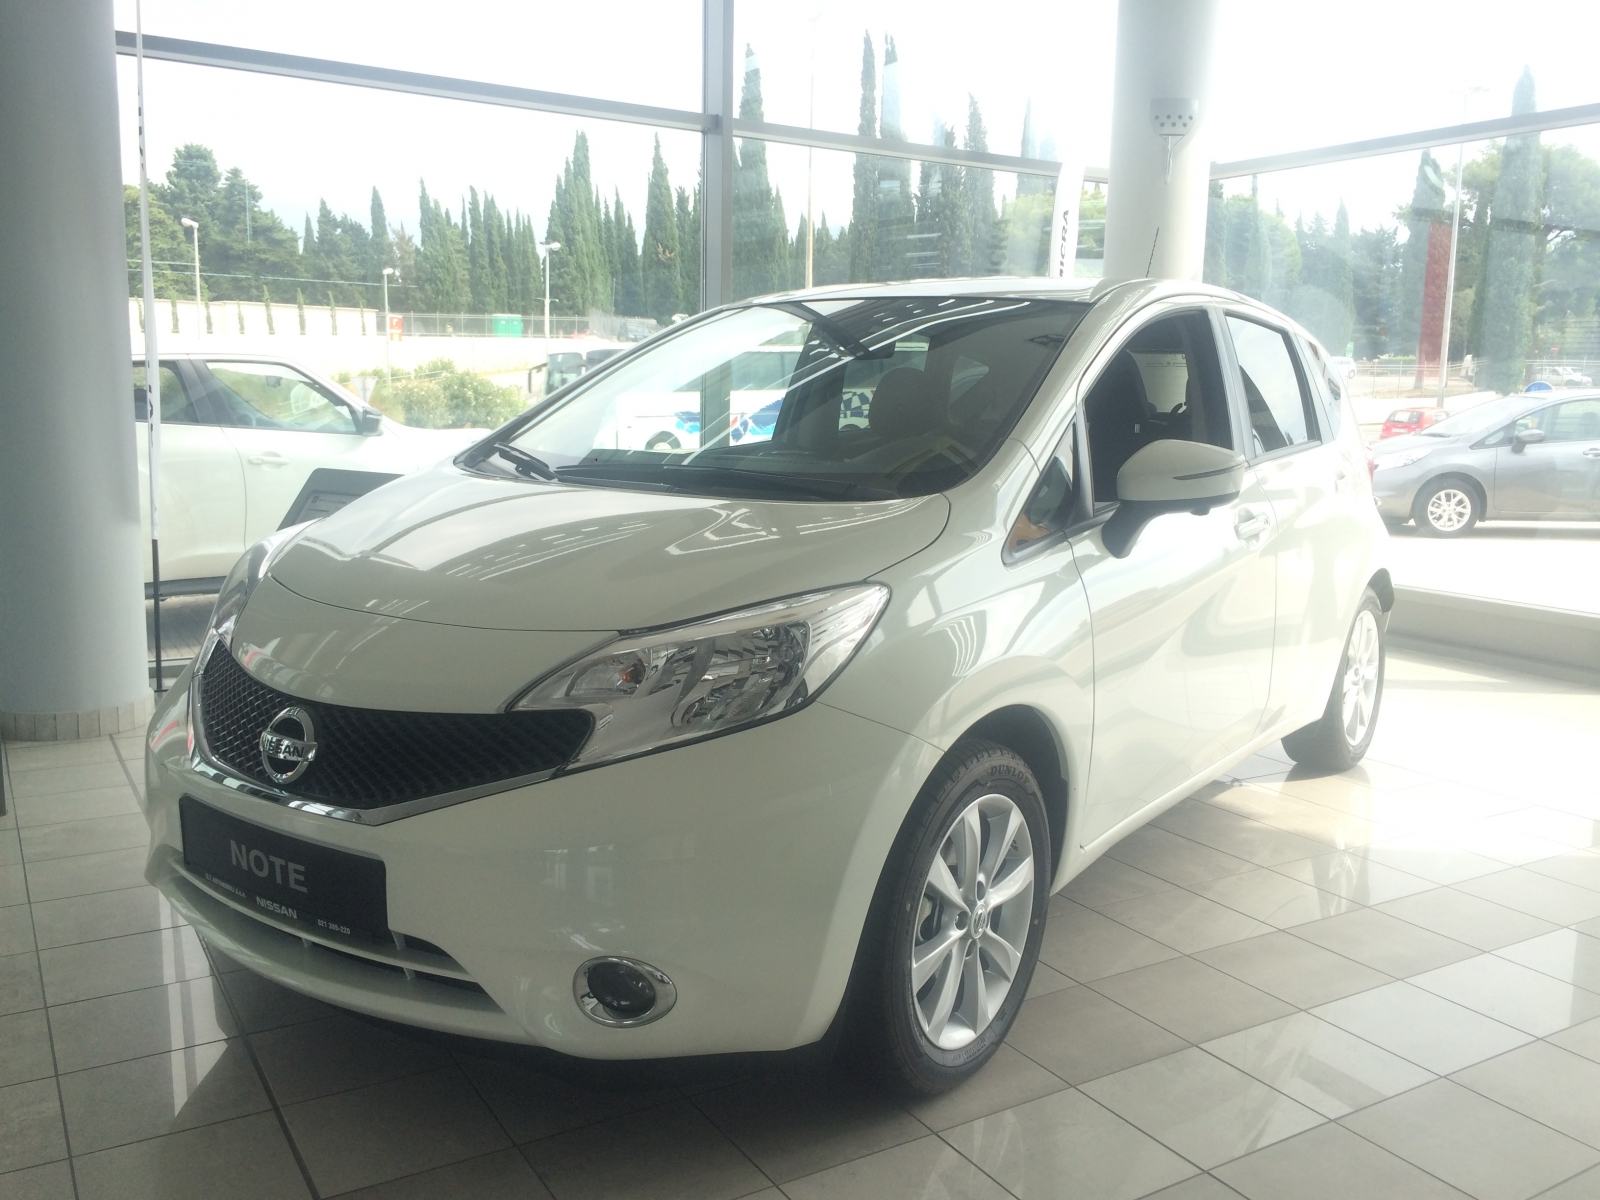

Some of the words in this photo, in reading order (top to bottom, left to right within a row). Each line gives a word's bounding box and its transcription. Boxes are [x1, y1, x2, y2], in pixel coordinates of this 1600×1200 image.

[262, 735, 305, 758] NISSAN
[991, 764, 1031, 783] DUNLOP
[230, 840, 308, 893] NOTE
[256, 895, 298, 920] NISSAN
